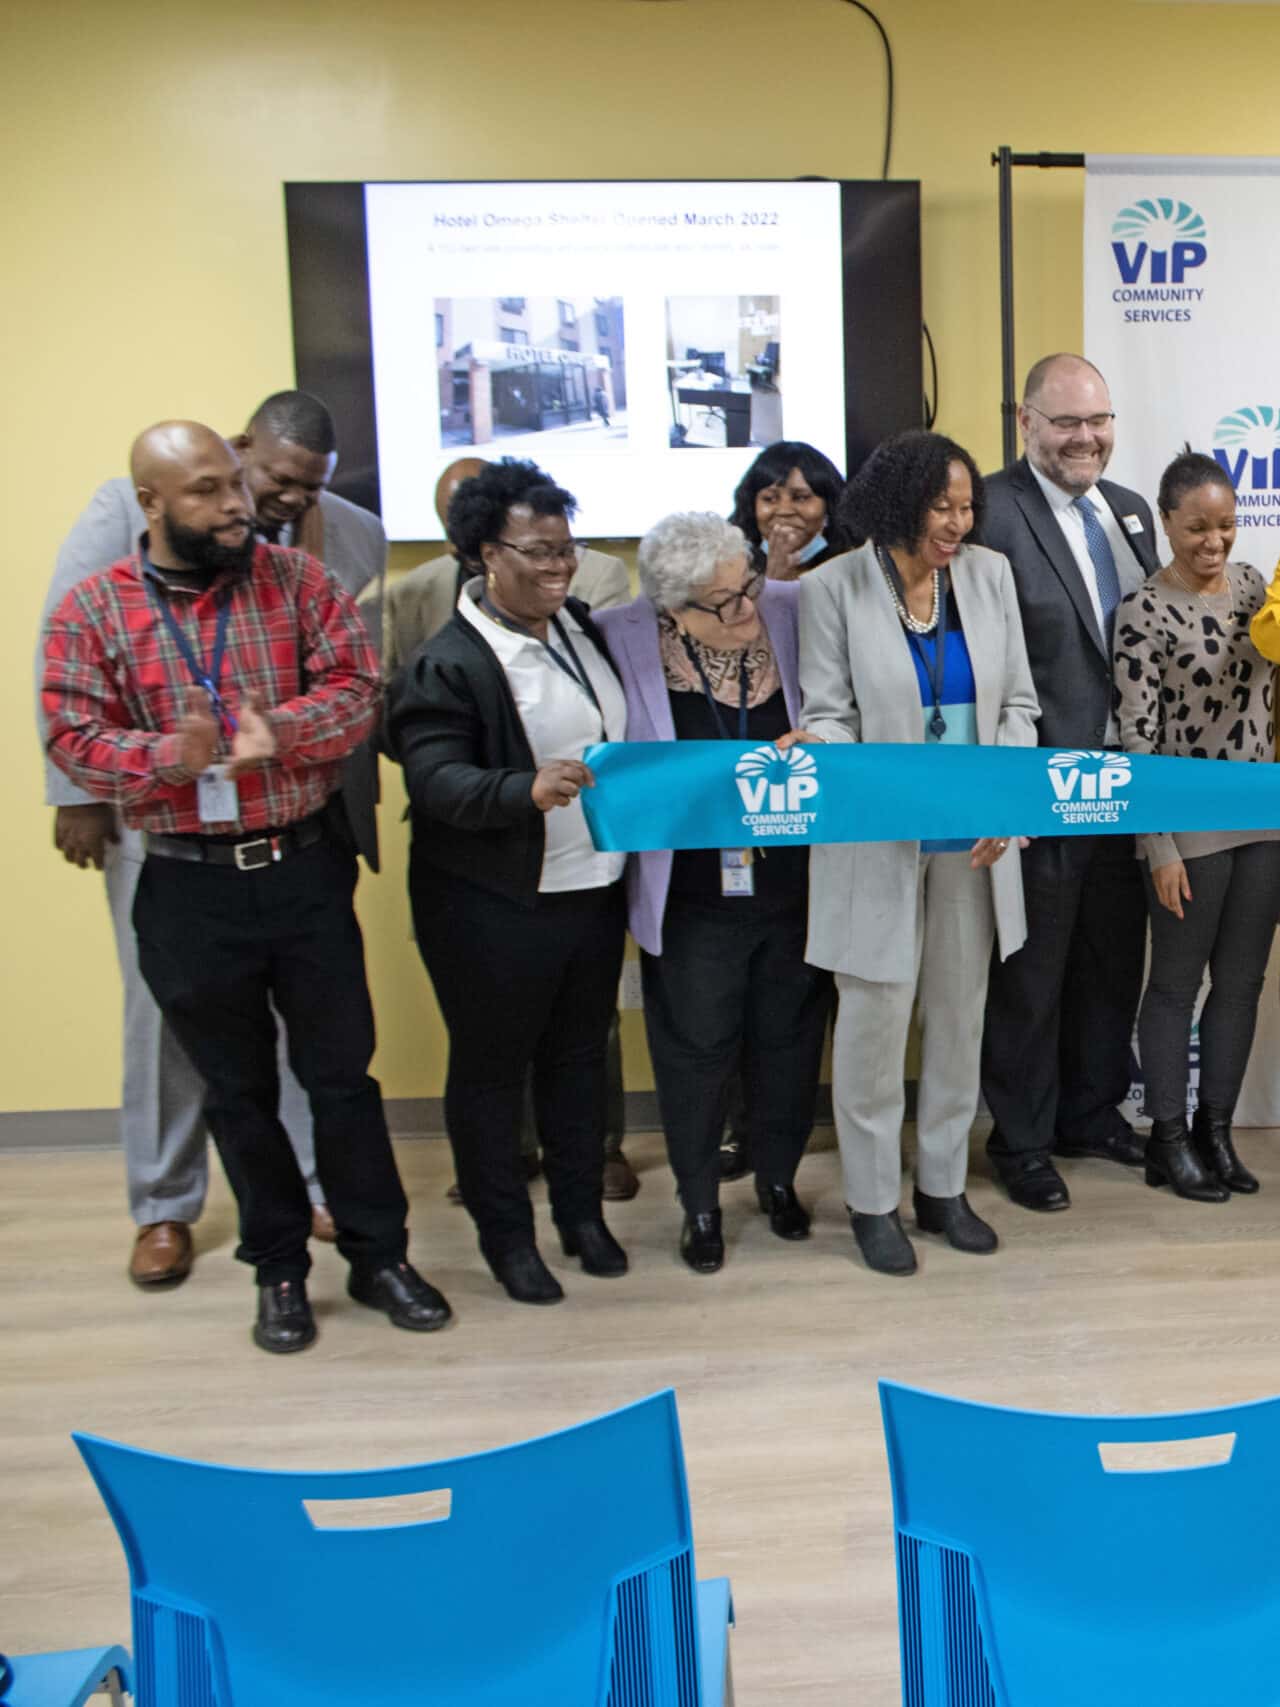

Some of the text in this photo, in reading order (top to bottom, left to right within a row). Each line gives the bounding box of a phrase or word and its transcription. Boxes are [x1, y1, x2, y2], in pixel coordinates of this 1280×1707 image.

[433, 212, 478, 227] Hotel
[482, 212, 542, 230] Omega
[683, 211, 735, 226] March
[740, 211, 780, 226] 2022
[1112, 288, 1204, 302] COMMUNITY
[1124, 309, 1191, 322] SERVICES
[1051, 801, 1129, 814] COMMUNITY
[741, 812, 817, 826] COMMUNITY
[1062, 812, 1119, 824] SERVICES
[752, 824, 808, 836] SERVICES
